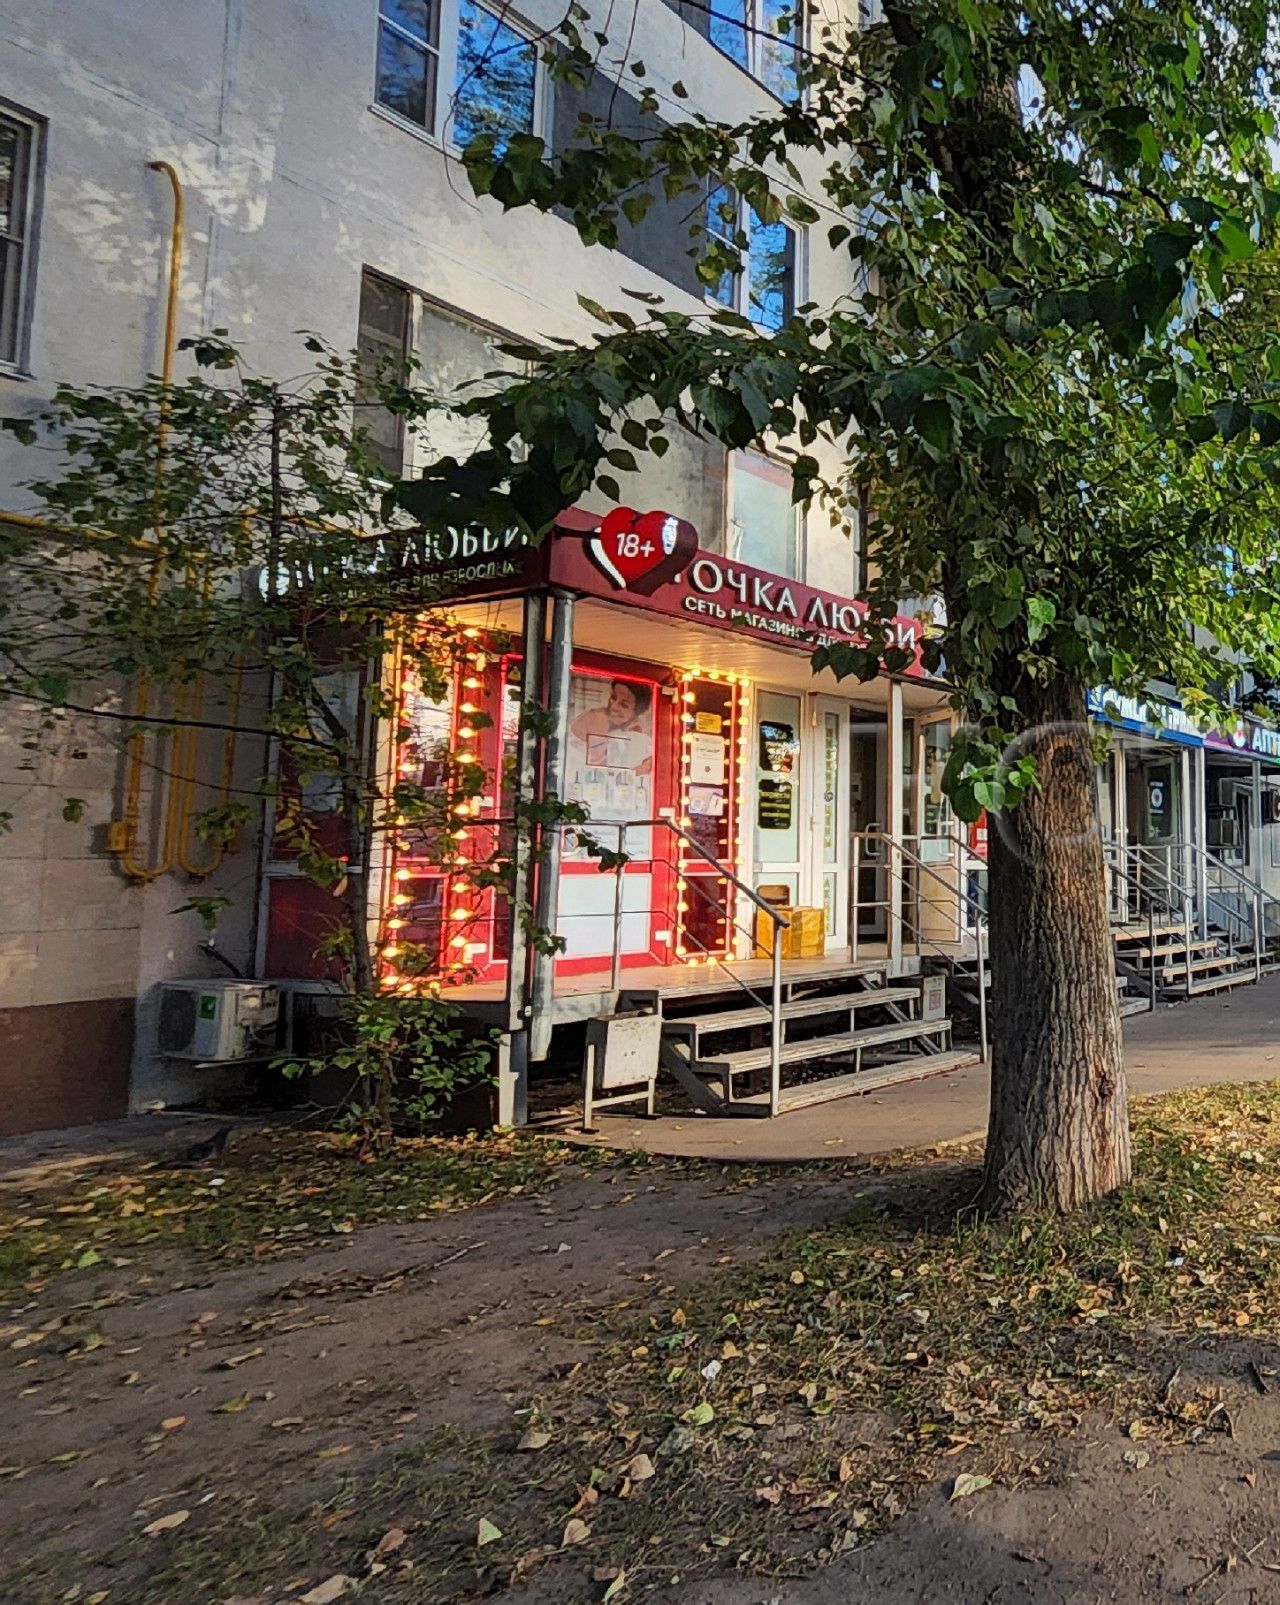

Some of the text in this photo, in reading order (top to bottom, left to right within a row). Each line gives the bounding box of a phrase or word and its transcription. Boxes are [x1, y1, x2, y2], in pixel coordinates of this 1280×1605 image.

[616, 533, 655, 557] 18+
[674, 559, 797, 618] ОЧКА
[685, 596, 727, 618] СЕТЬ
